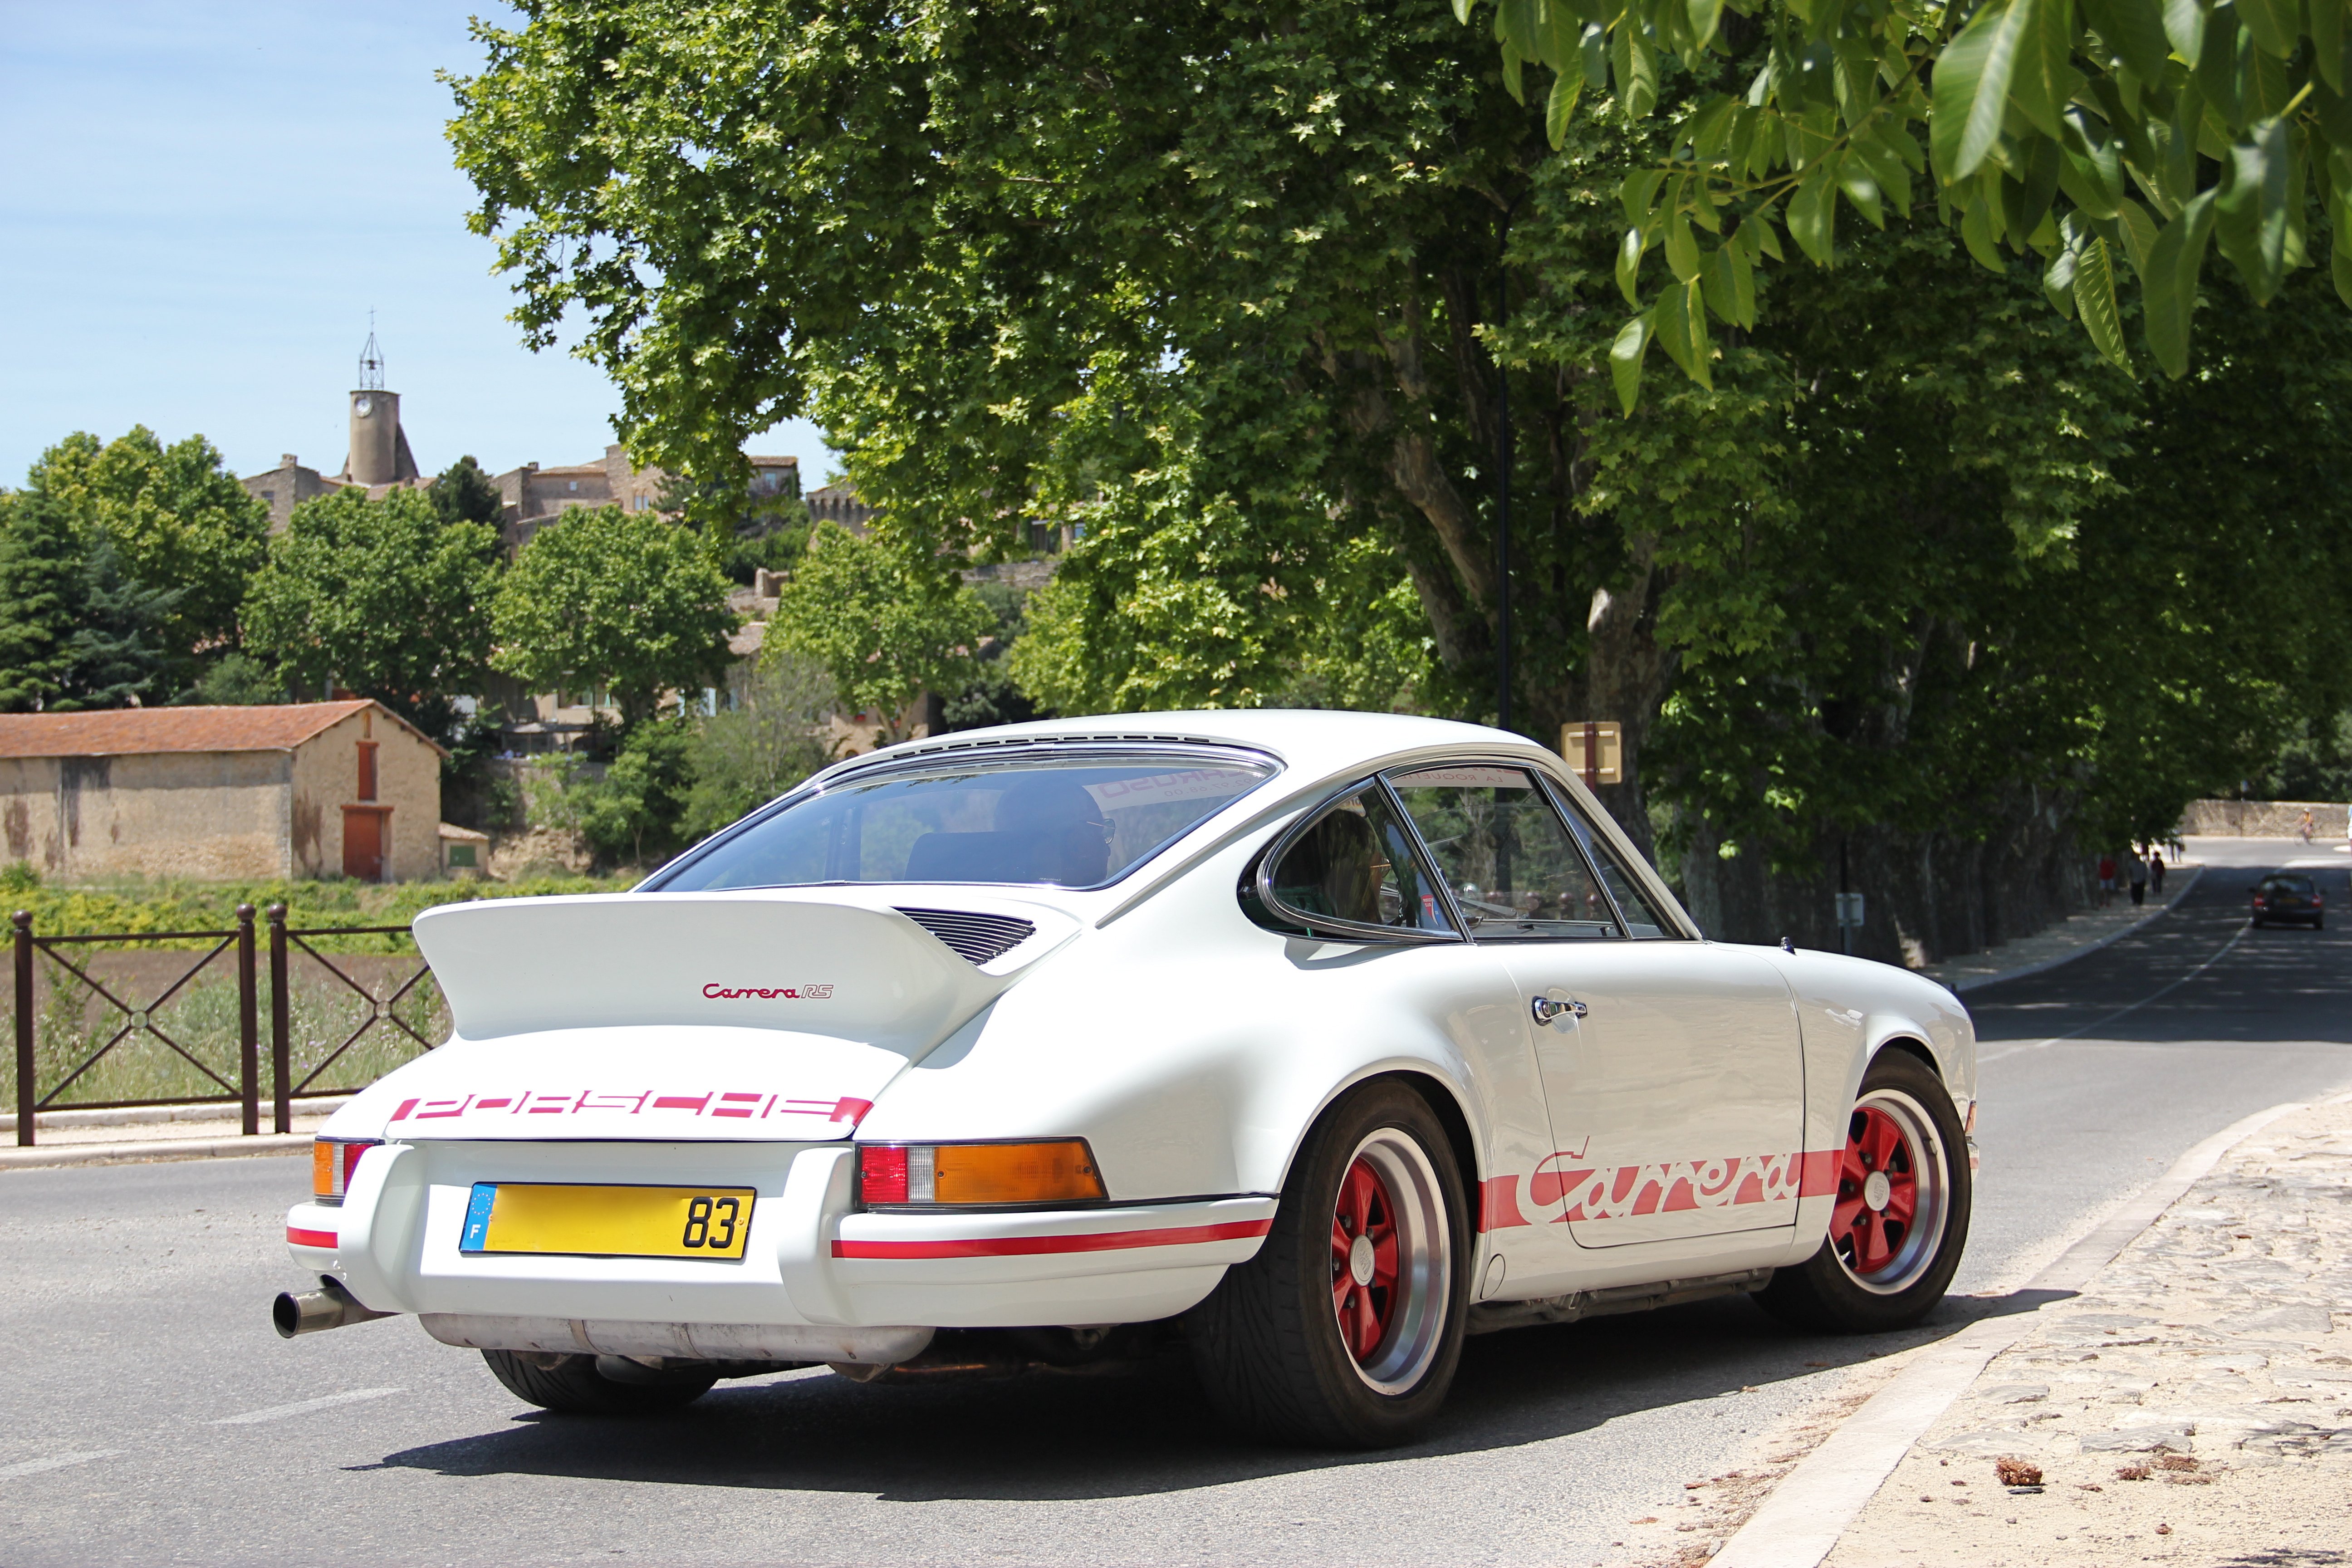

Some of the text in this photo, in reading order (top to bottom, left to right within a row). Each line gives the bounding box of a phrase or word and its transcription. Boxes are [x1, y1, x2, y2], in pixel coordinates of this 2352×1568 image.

[703, 983, 834, 998] Carrera RS
[402, 1090, 844, 1122] PORSCHE
[1518, 1136, 1801, 1224] Carrera
[470, 1225, 480, 1239] F
[683, 1197, 740, 1248] 83
